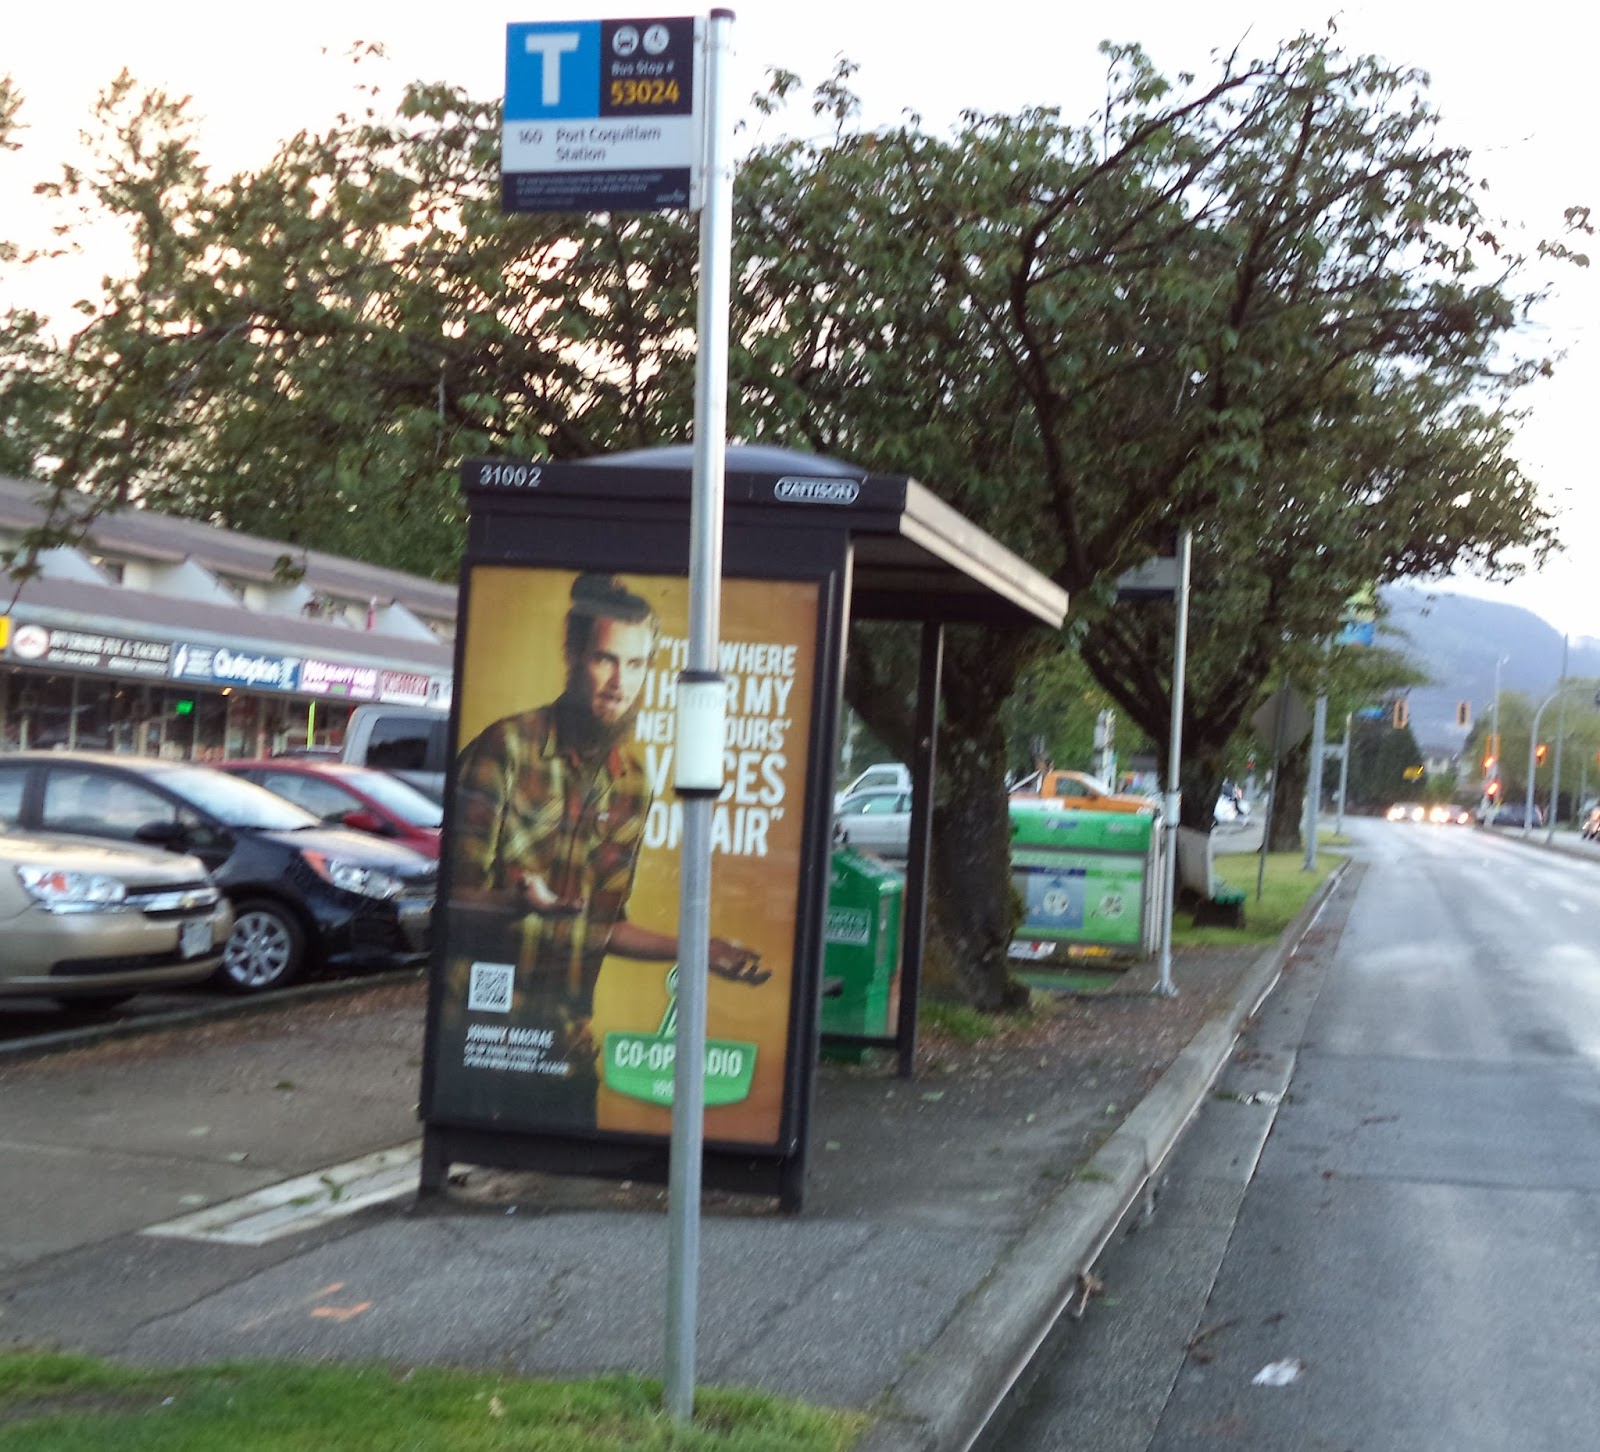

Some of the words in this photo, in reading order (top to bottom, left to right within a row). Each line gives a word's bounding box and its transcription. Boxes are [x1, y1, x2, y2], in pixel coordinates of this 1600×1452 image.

[525, 33, 579, 106] T
[611, 60, 634, 76] Bus
[636, 59, 664, 76] Stop
[611, 78, 679, 105] 53024
[555, 126, 585, 144] Port
[589, 124, 661, 145] Coquitlam
[555, 147, 607, 162] Station
[480, 465, 542, 487] 31002
[778, 480, 855, 502] PATTISON
[718, 642, 798, 677] WHERE
[645, 670, 655, 708] I
[657, 673, 740, 714] HR
[743, 677, 794, 716] MY
[635, 711, 792, 751] NEIOURS'
[645, 746, 787, 806] VCES
[615, 1039, 677, 1072] CO-OP
